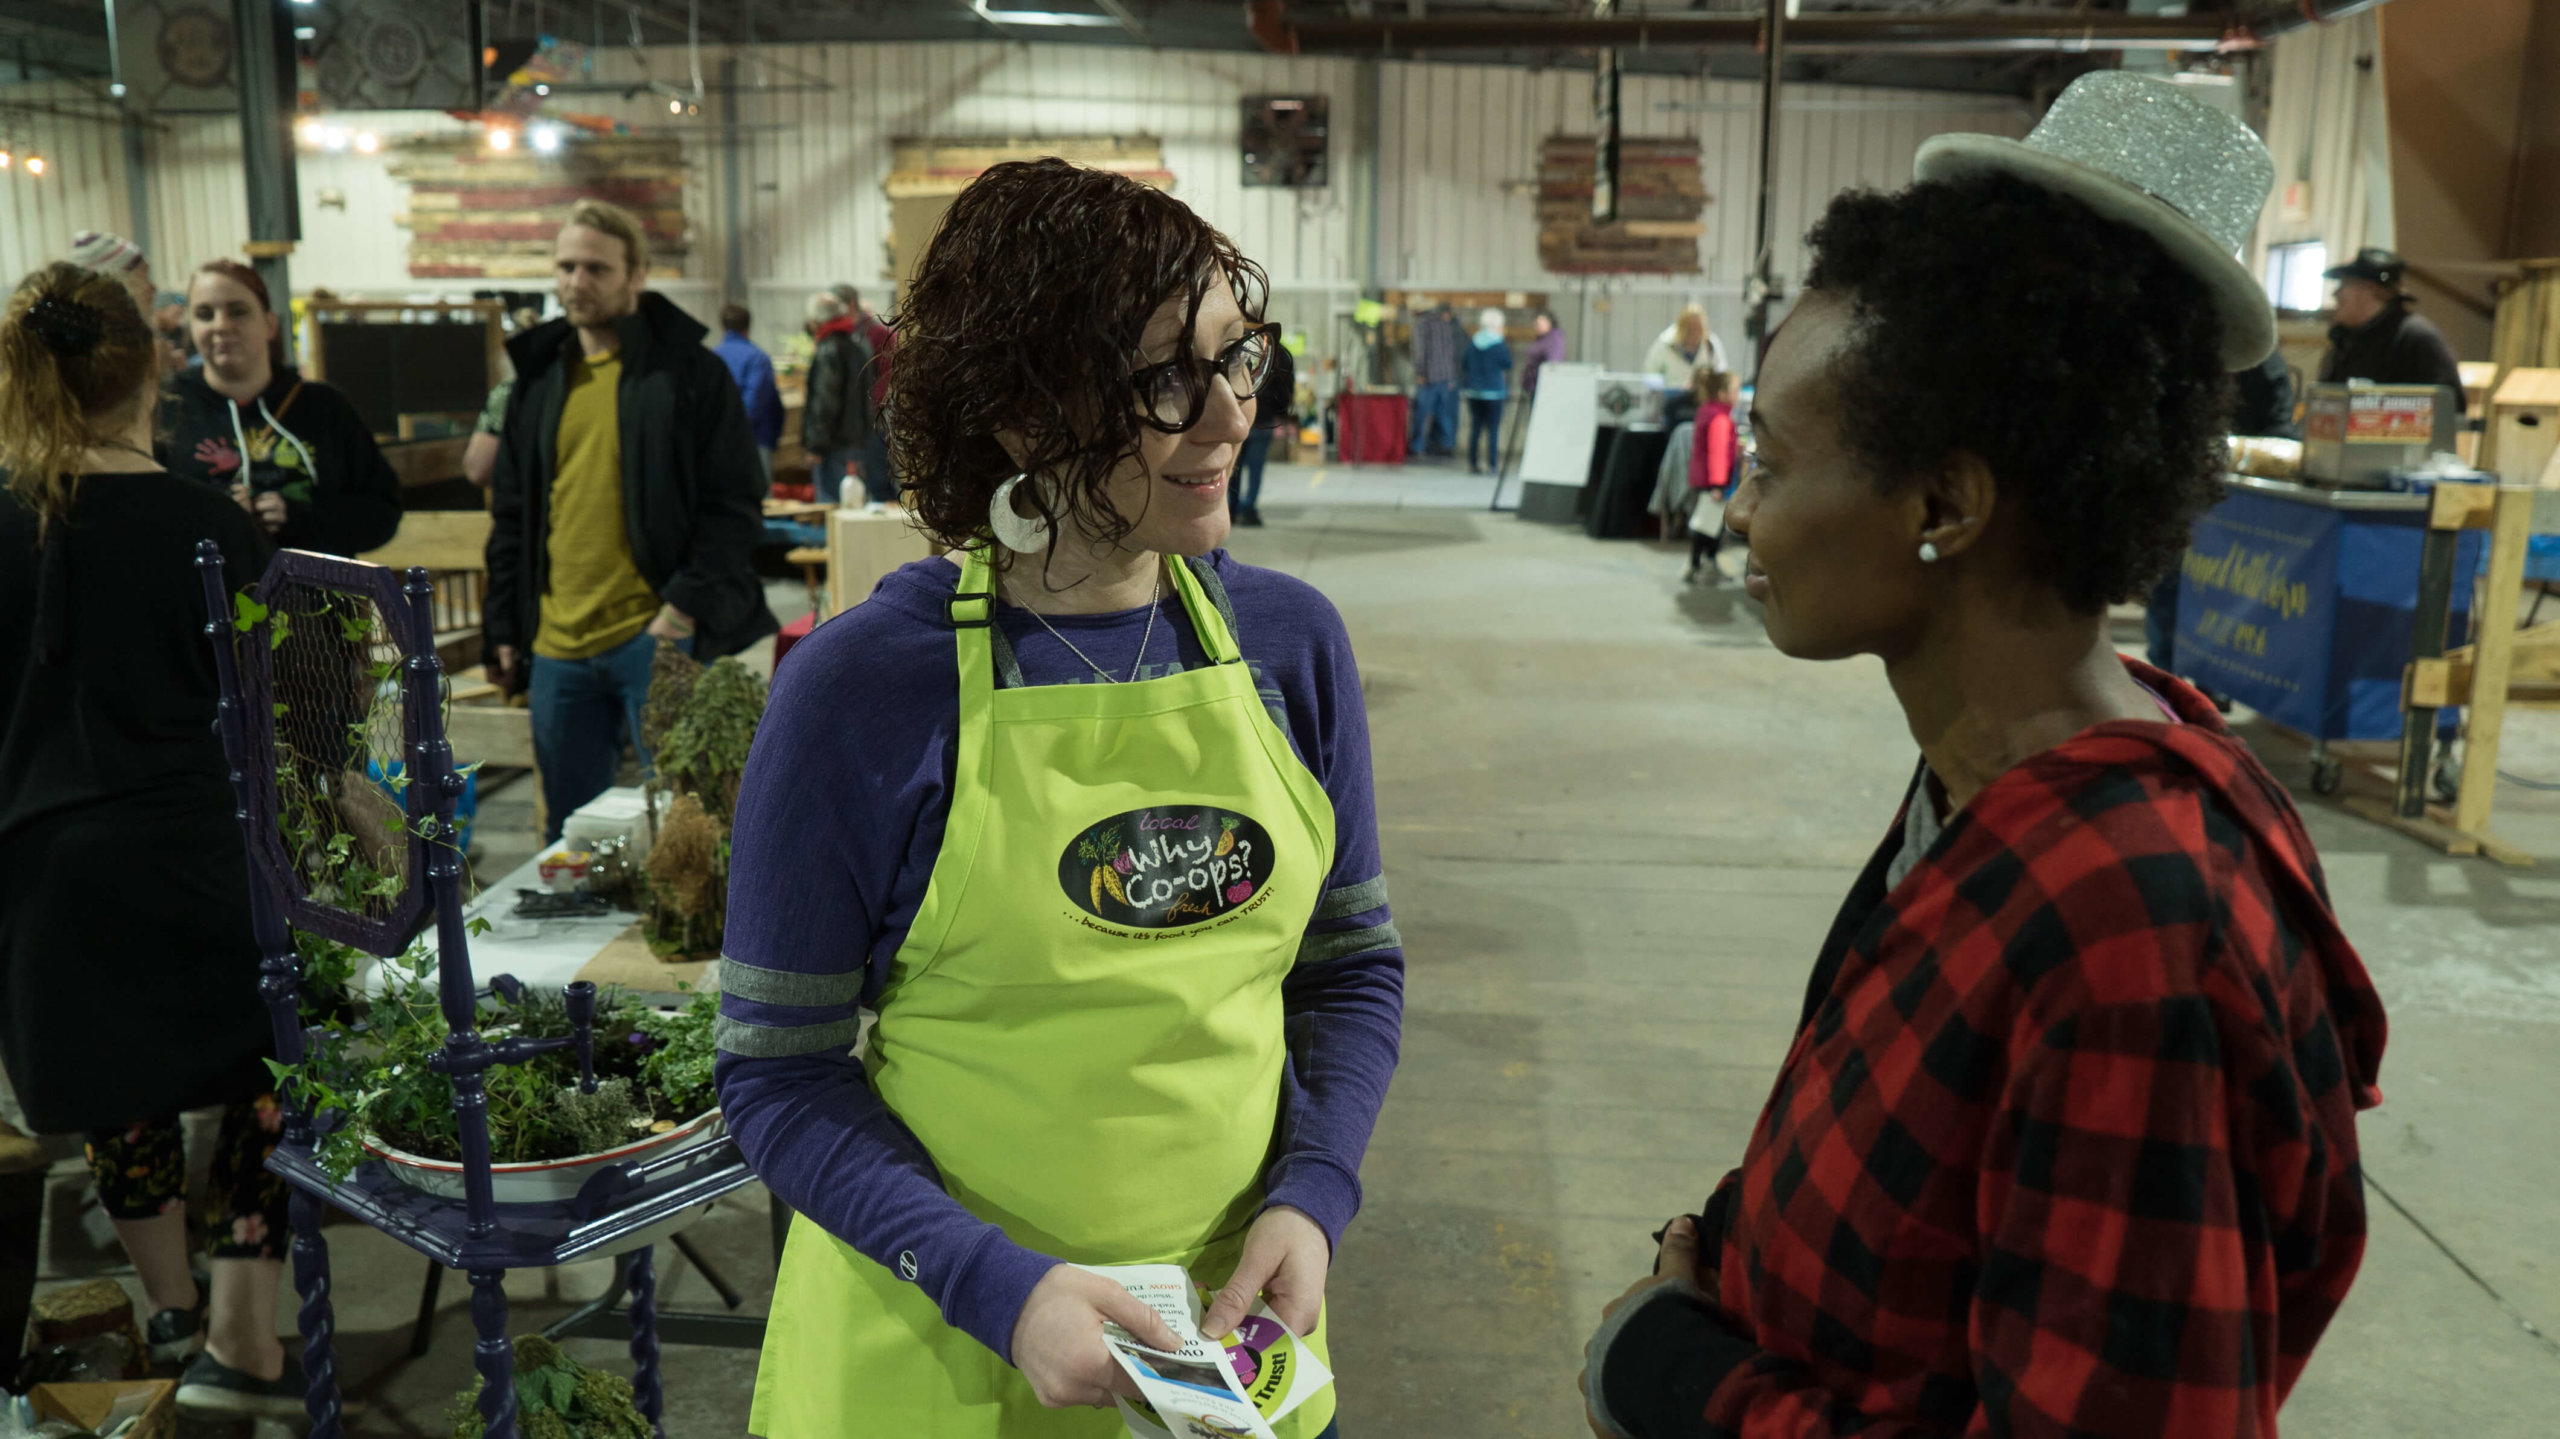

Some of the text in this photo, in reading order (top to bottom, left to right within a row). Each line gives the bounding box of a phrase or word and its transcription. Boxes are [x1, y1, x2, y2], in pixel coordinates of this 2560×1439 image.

[1140, 811, 1200, 831] local
[1126, 839, 1252, 909] Co-ops?
[1128, 833, 1213, 873] Why
[1154, 930, 1186, 942] food
[1190, 925, 1213, 938] you
[1217, 915, 1240, 927] can
[1240, 886, 1275, 917] TRUST!
[1161, 892, 1214, 923] fresh
[1255, 1351, 1287, 1401] Trust!
